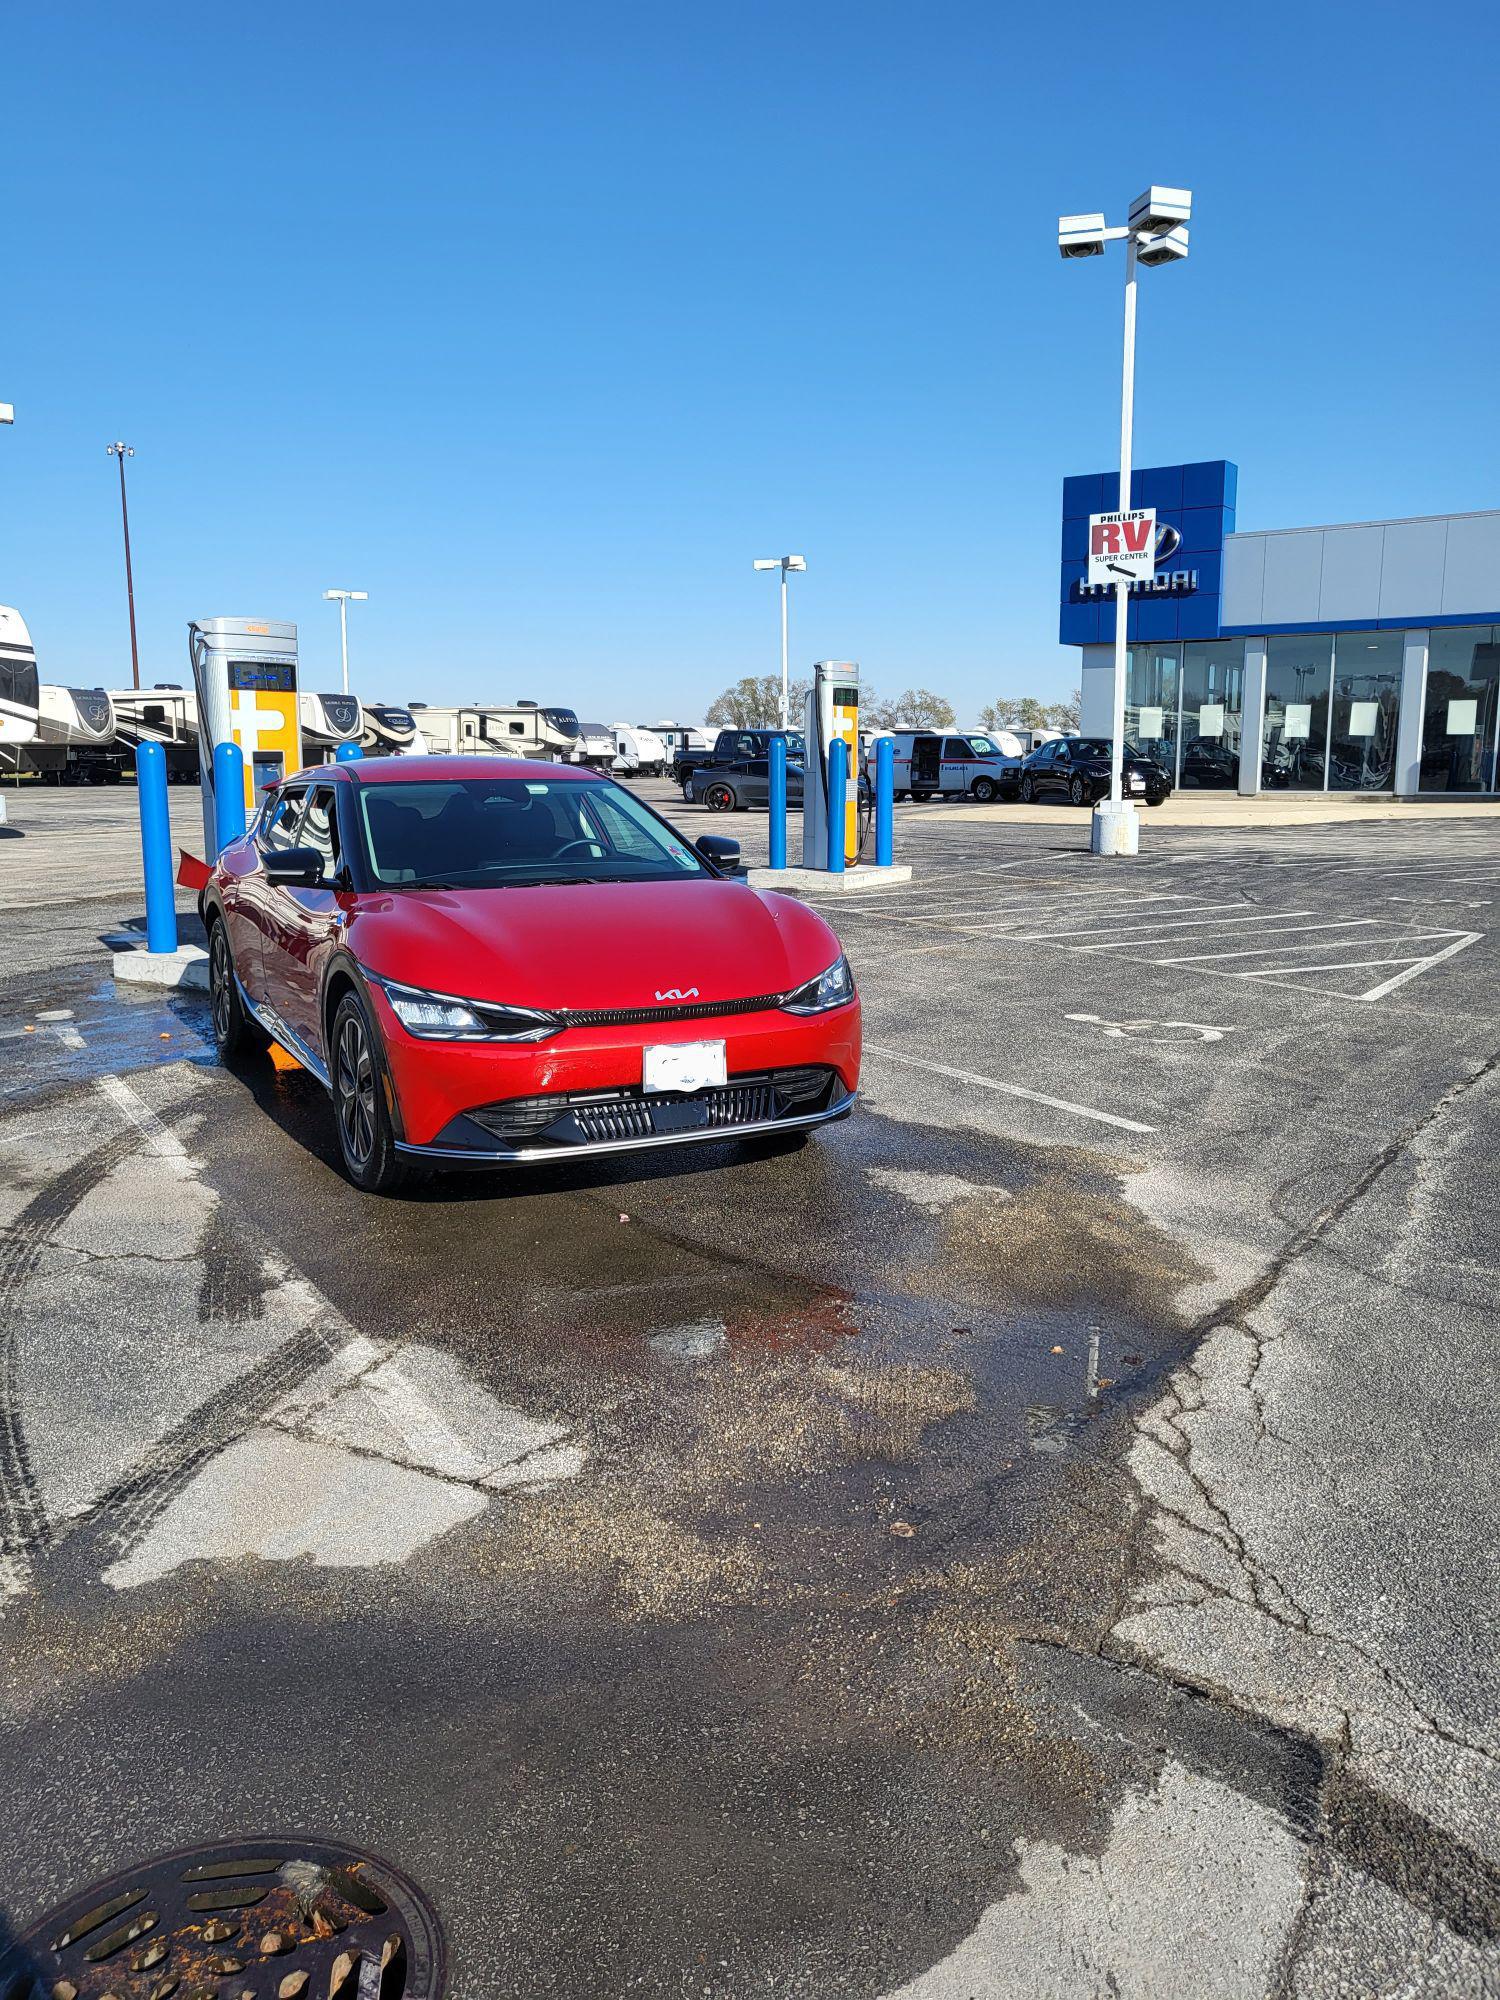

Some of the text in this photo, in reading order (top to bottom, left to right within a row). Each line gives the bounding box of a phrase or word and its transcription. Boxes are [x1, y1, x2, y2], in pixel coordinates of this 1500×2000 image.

[1100, 511, 1145, 523] PHILLIPS
[1091, 519, 1153, 556] RV
[1094, 552, 1149, 563] SUPER CENTER
[655, 987, 700, 1001] KIA
